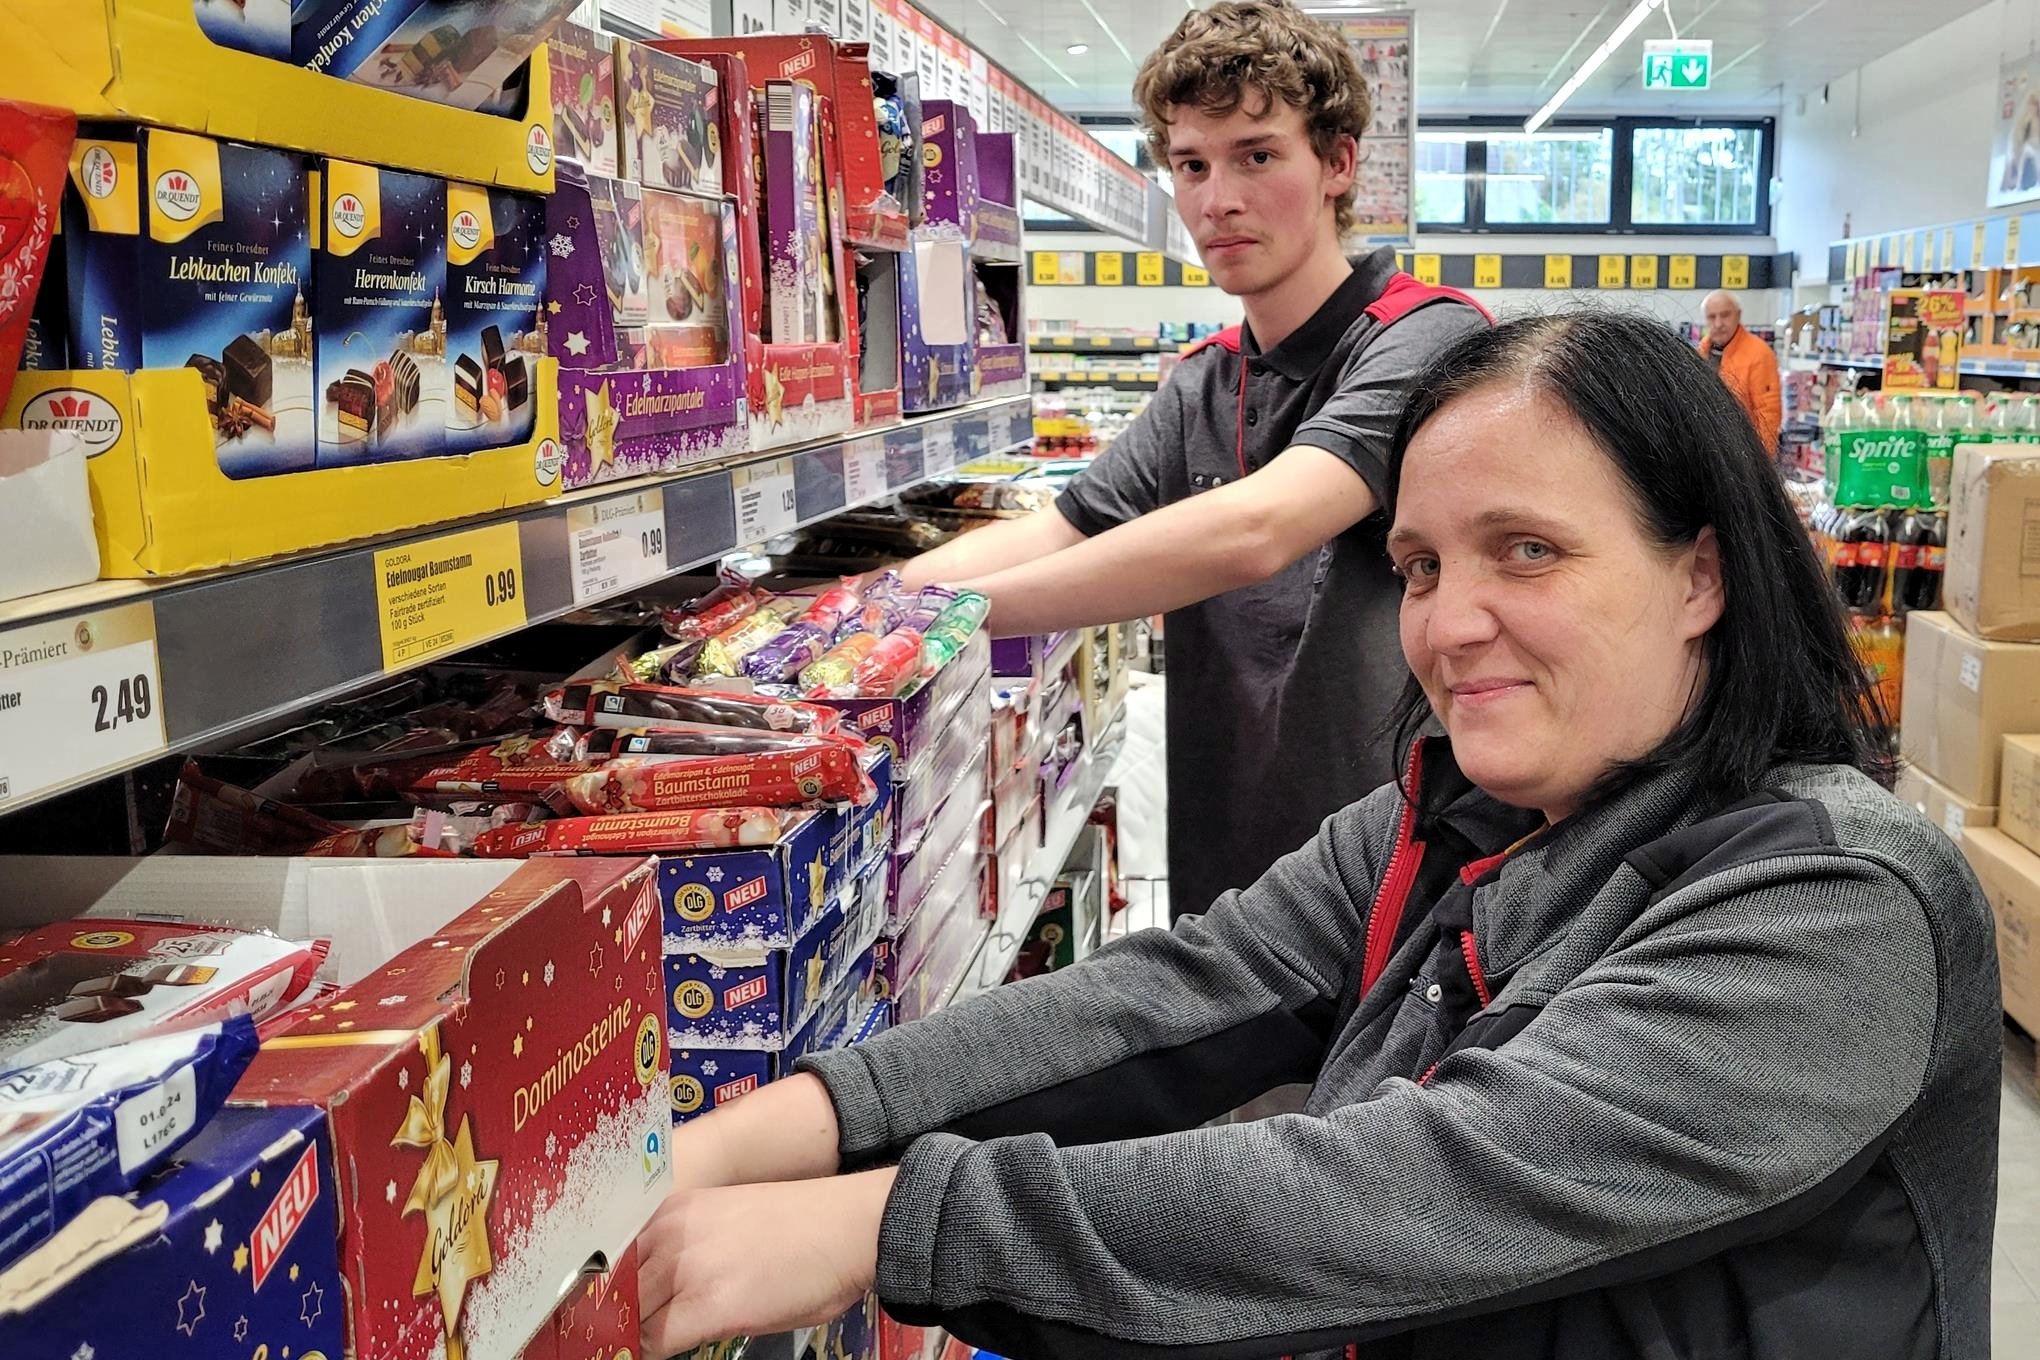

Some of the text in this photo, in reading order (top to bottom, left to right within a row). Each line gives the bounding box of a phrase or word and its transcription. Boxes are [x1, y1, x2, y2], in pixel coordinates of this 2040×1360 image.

[784, 57, 811, 76] NEU
[168, 191, 200, 205] QUENDT
[207, 240, 269, 255] Feines Dresdner
[169, 256, 297, 288] Lebkuchen Konfekt
[355, 268, 427, 294] Herrenkonfekt
[204, 293, 217, 302] mit
[218, 291, 238, 303] feiner
[465, 276, 536, 297] Kirsch Harmonie
[1848, 435, 1916, 463] Sprite
[641, 528, 663, 558] 0,99
[384, 554, 412, 568] GOLDORA
[386, 554, 473, 588] Edelnougat Baumstamm
[388, 582, 447, 605] verschiedene Sorten
[485, 568, 516, 607] 0,99
[389, 595, 446, 619] Fairtrade zertifiziert
[391, 619, 402, 632] 100
[408, 612, 425, 626] Stück
[91, 673, 152, 733] 2,49
[861, 708, 889, 727] NEU
[653, 768, 702, 781] Edelmarzipan
[712, 762, 755, 777] Edelnougat
[794, 755, 818, 773] NEU
[654, 772, 750, 796] Baumstamm
[655, 788, 749, 806] Zartbitterschokolade
[589, 815, 691, 833] Baumstamm
[640, 828, 690, 838] Edelmarzipan
[518, 830, 543, 847] NEU
[582, 830, 626, 842] Edelnougat
[686, 891, 704, 909] DLG
[729, 882, 761, 908] NEU
[627, 887, 654, 948] NEU
[681, 924, 717, 933] Zartbitter
[686, 989, 702, 1006] DLG
[729, 980, 761, 1006] NEU
[642, 1031, 654, 1065] DLG
[513, 997, 632, 1133] Dominosteine
[676, 1083, 693, 1100] DLG
[720, 1079, 752, 1102] NEU
[260, 1165, 313, 1268] NEU
[431, 1186, 488, 1289] Goldora
